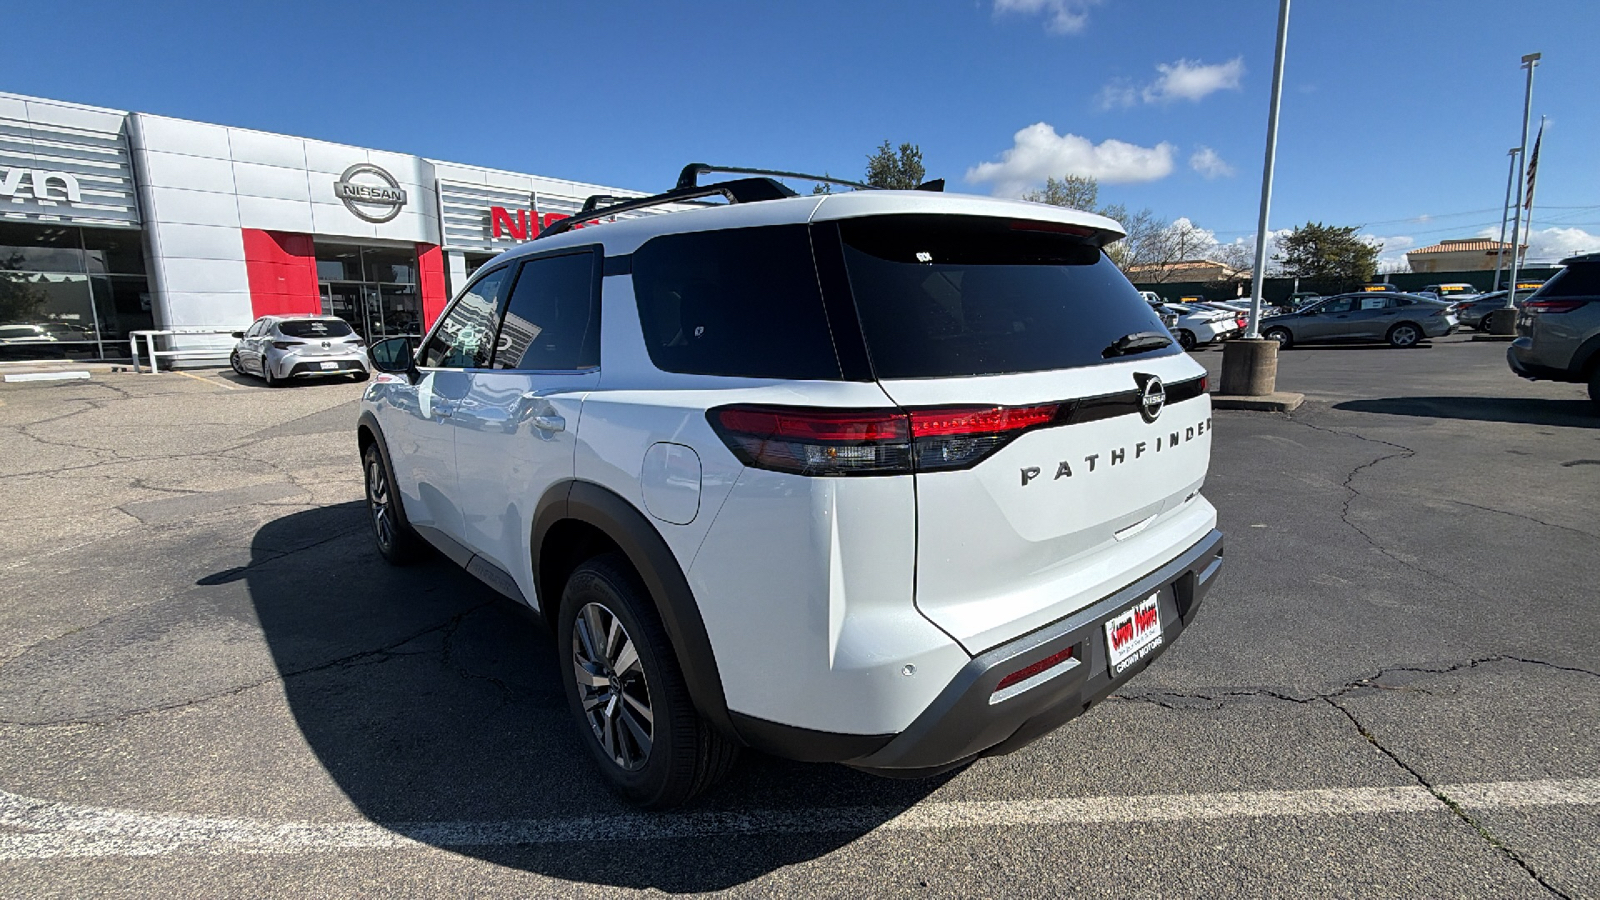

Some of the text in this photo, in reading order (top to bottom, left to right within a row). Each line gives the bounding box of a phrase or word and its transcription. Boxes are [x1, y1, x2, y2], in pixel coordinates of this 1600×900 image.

[343, 185, 401, 201] NISSAN
[1020, 417, 1212, 487] PATHFINDER
[1116, 652, 1138, 673] CROWN
[1139, 636, 1162, 659] MOTORS
